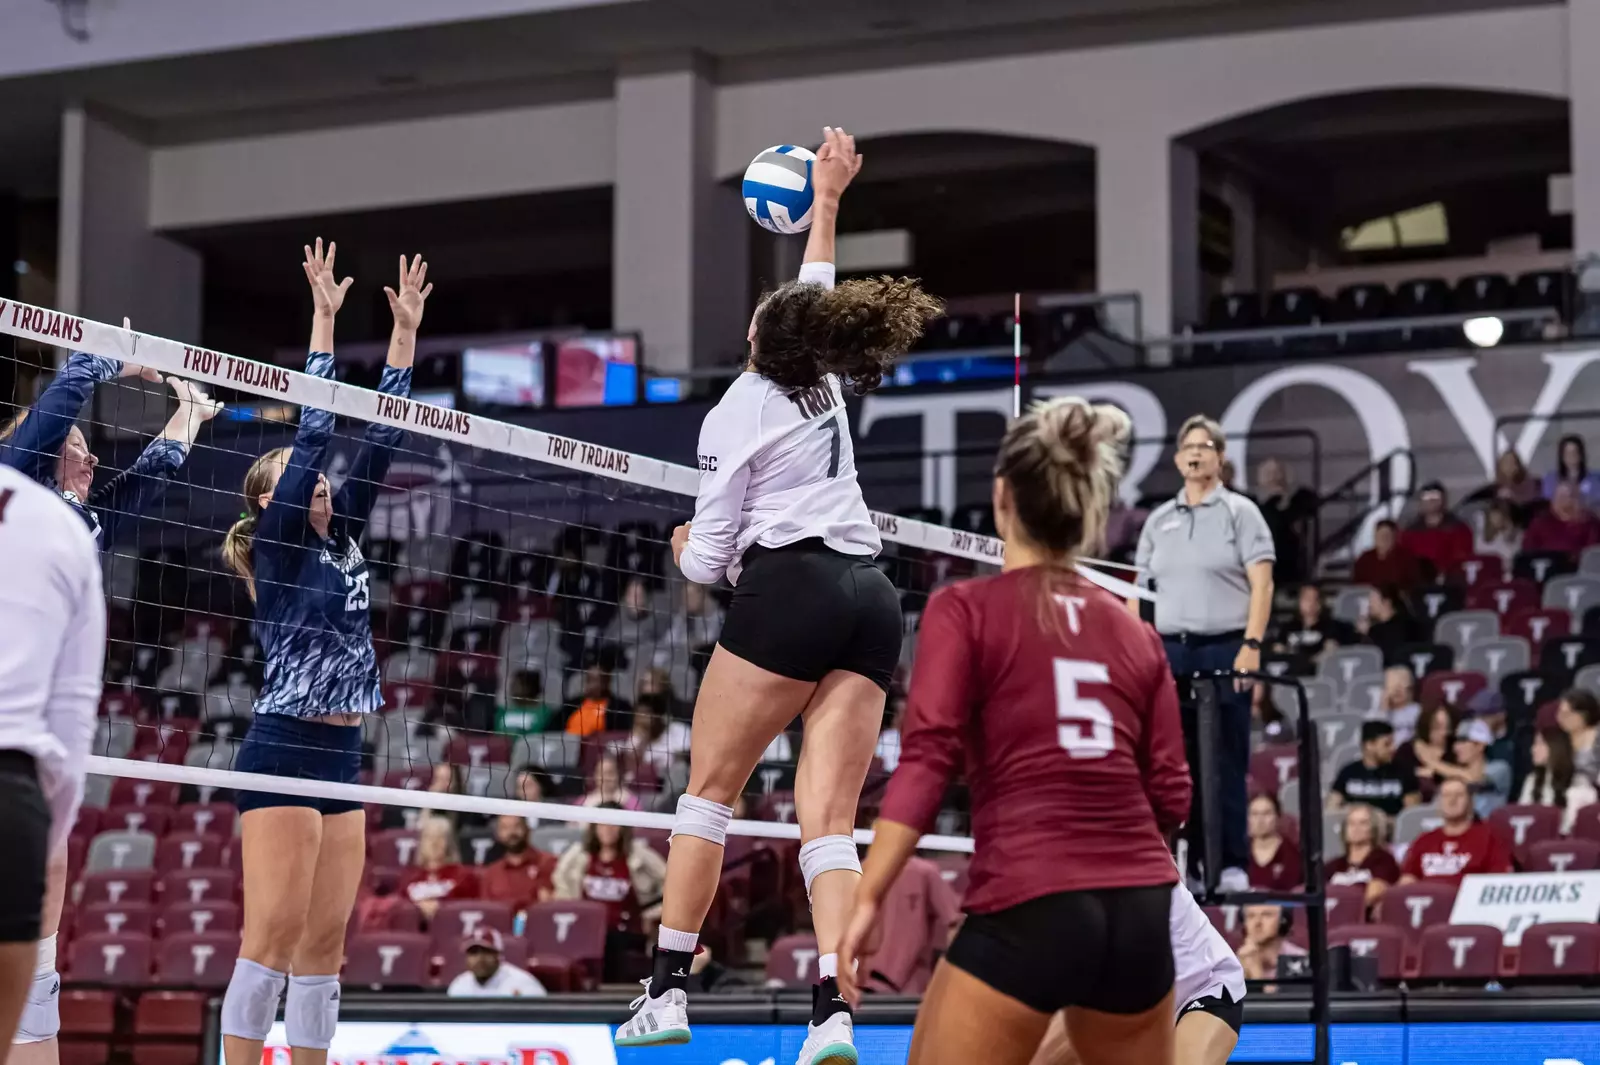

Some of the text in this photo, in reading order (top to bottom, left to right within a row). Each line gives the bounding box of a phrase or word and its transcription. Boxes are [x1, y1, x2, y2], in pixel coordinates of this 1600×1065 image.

[12, 304, 84, 343] TROJANS
[183, 346, 290, 394] TROY TROJANS
[377, 394, 471, 436] TROY TROJANS
[787, 376, 839, 421] TROY
[547, 436, 630, 475] TROY TROJANS
[698, 454, 718, 472] BC
[345, 570, 370, 612] 25
[1053, 594, 1087, 636] T
[1053, 657, 1116, 759] 5
[1479, 881, 1584, 906] BROOKS
